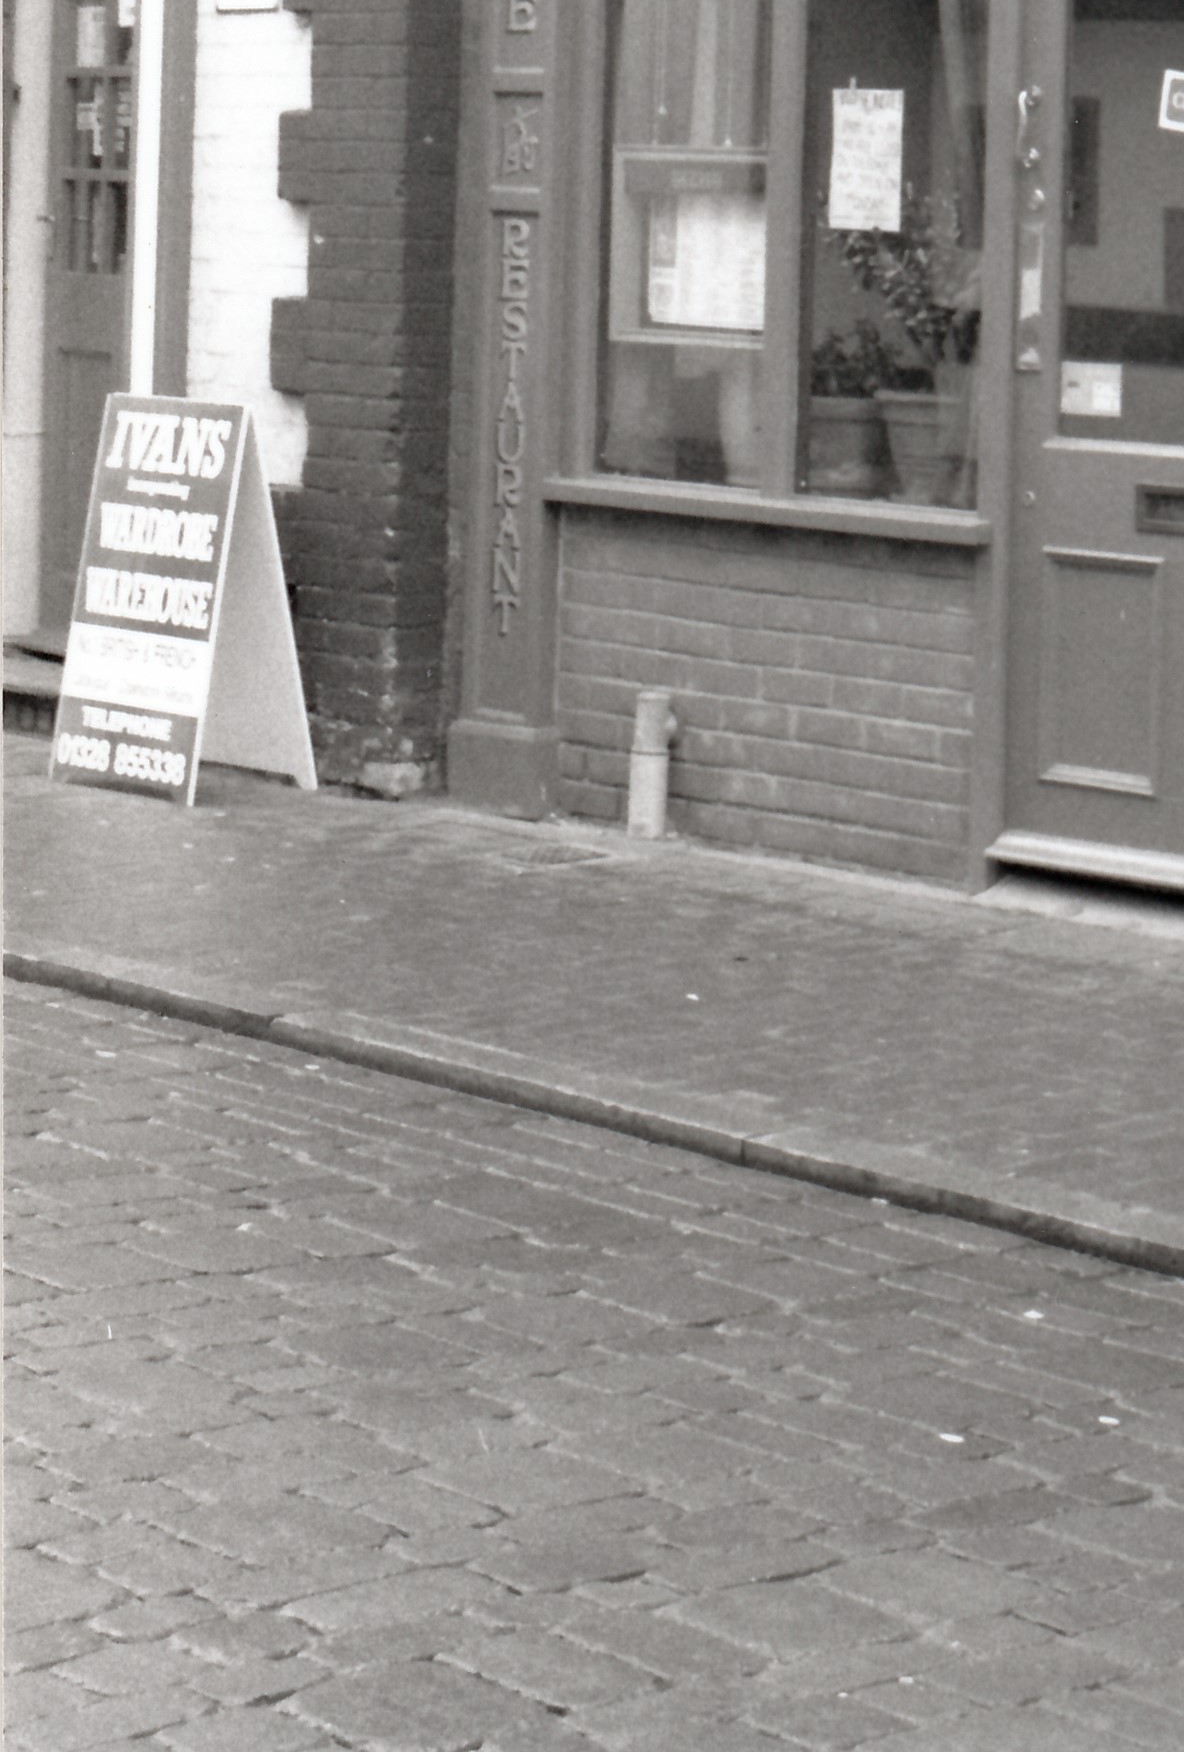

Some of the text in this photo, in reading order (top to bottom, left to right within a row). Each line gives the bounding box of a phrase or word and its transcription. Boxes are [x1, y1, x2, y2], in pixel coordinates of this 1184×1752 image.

[106, 412, 232, 478] IVANS
[493, 218, 530, 637] RESTAURANT
[100, 502, 218, 562] WARDROBE
[85, 566, 213, 629] WAREHOUSE
[82, 705, 173, 741] TELEPHONE
